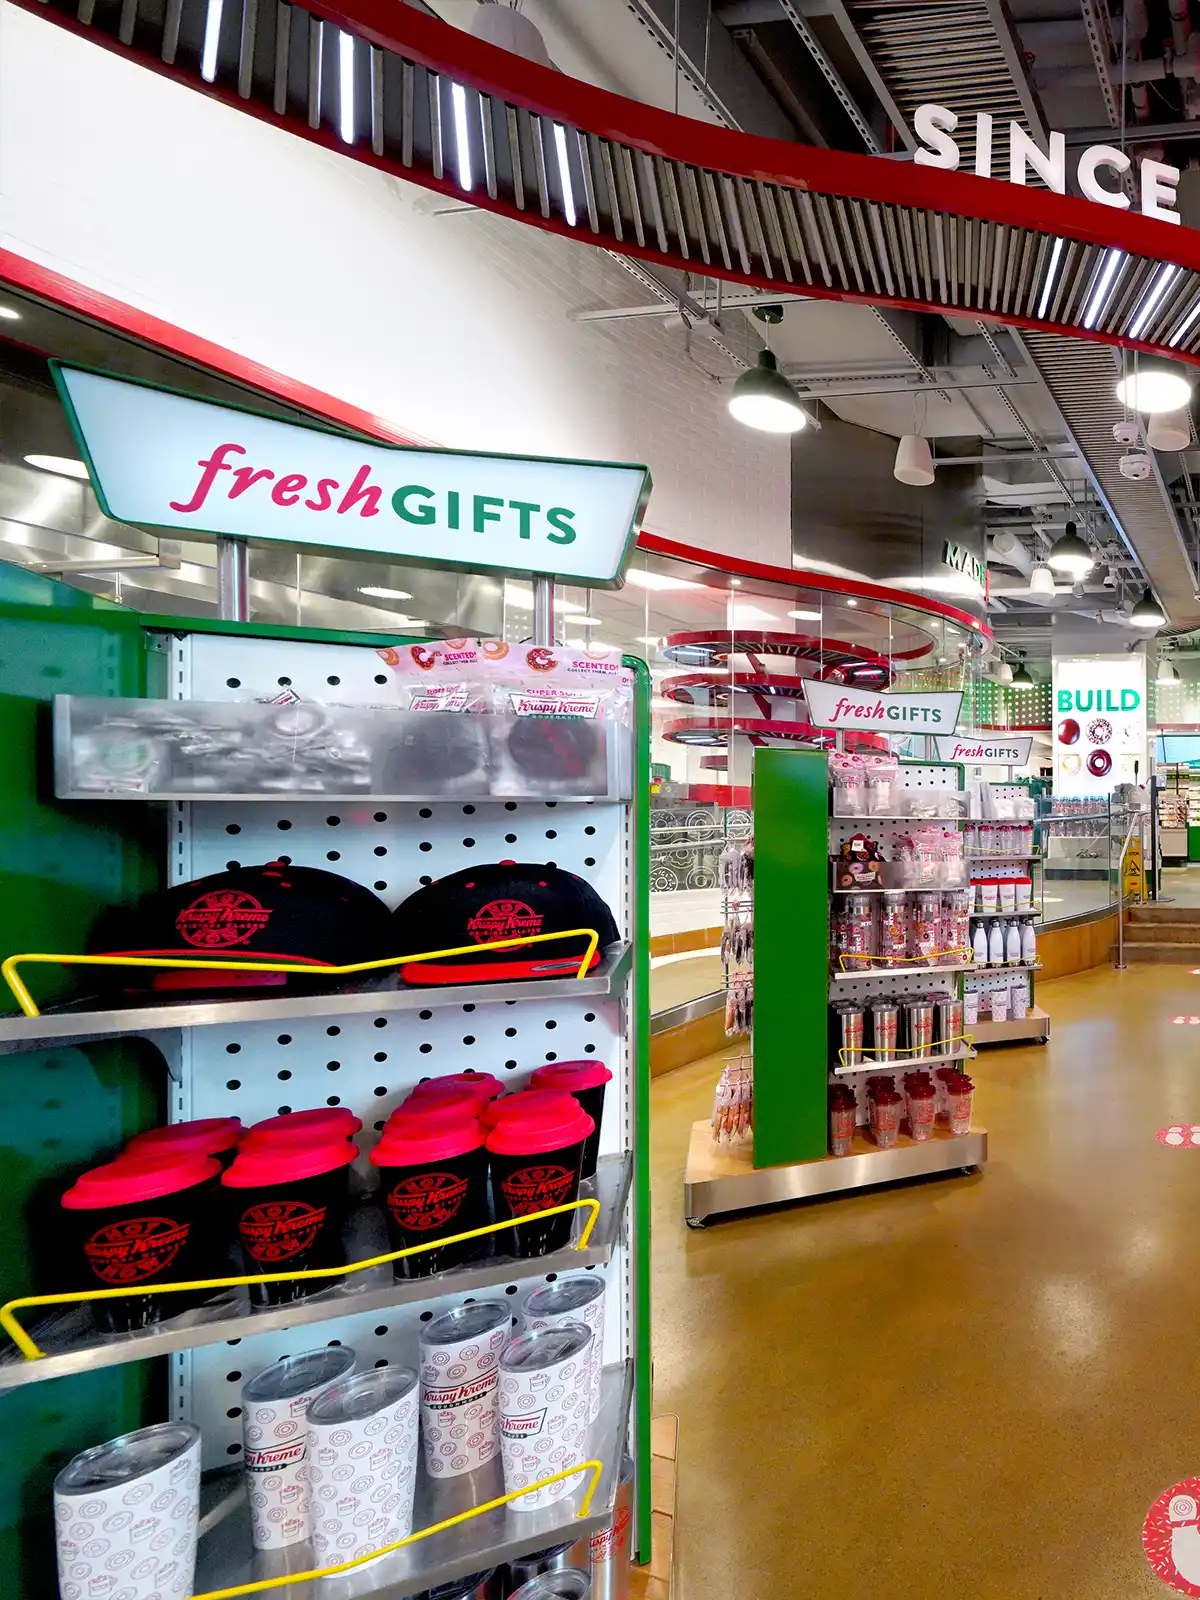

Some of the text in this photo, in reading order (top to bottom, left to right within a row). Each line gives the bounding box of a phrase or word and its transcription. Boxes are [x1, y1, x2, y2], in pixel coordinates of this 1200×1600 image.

[913, 103, 1181, 226] SINCE
[444, 652, 476, 661] SCENTED!
[572, 661, 619, 671] SCENTED!
[518, 699, 595, 714] Krispy Kreme
[1057, 688, 1140, 713] BUILD
[423, 1370, 499, 1403] Krispy Kreme
[504, 1415, 541, 1431] Kreme
[256, 1442, 305, 1465] Kreme
